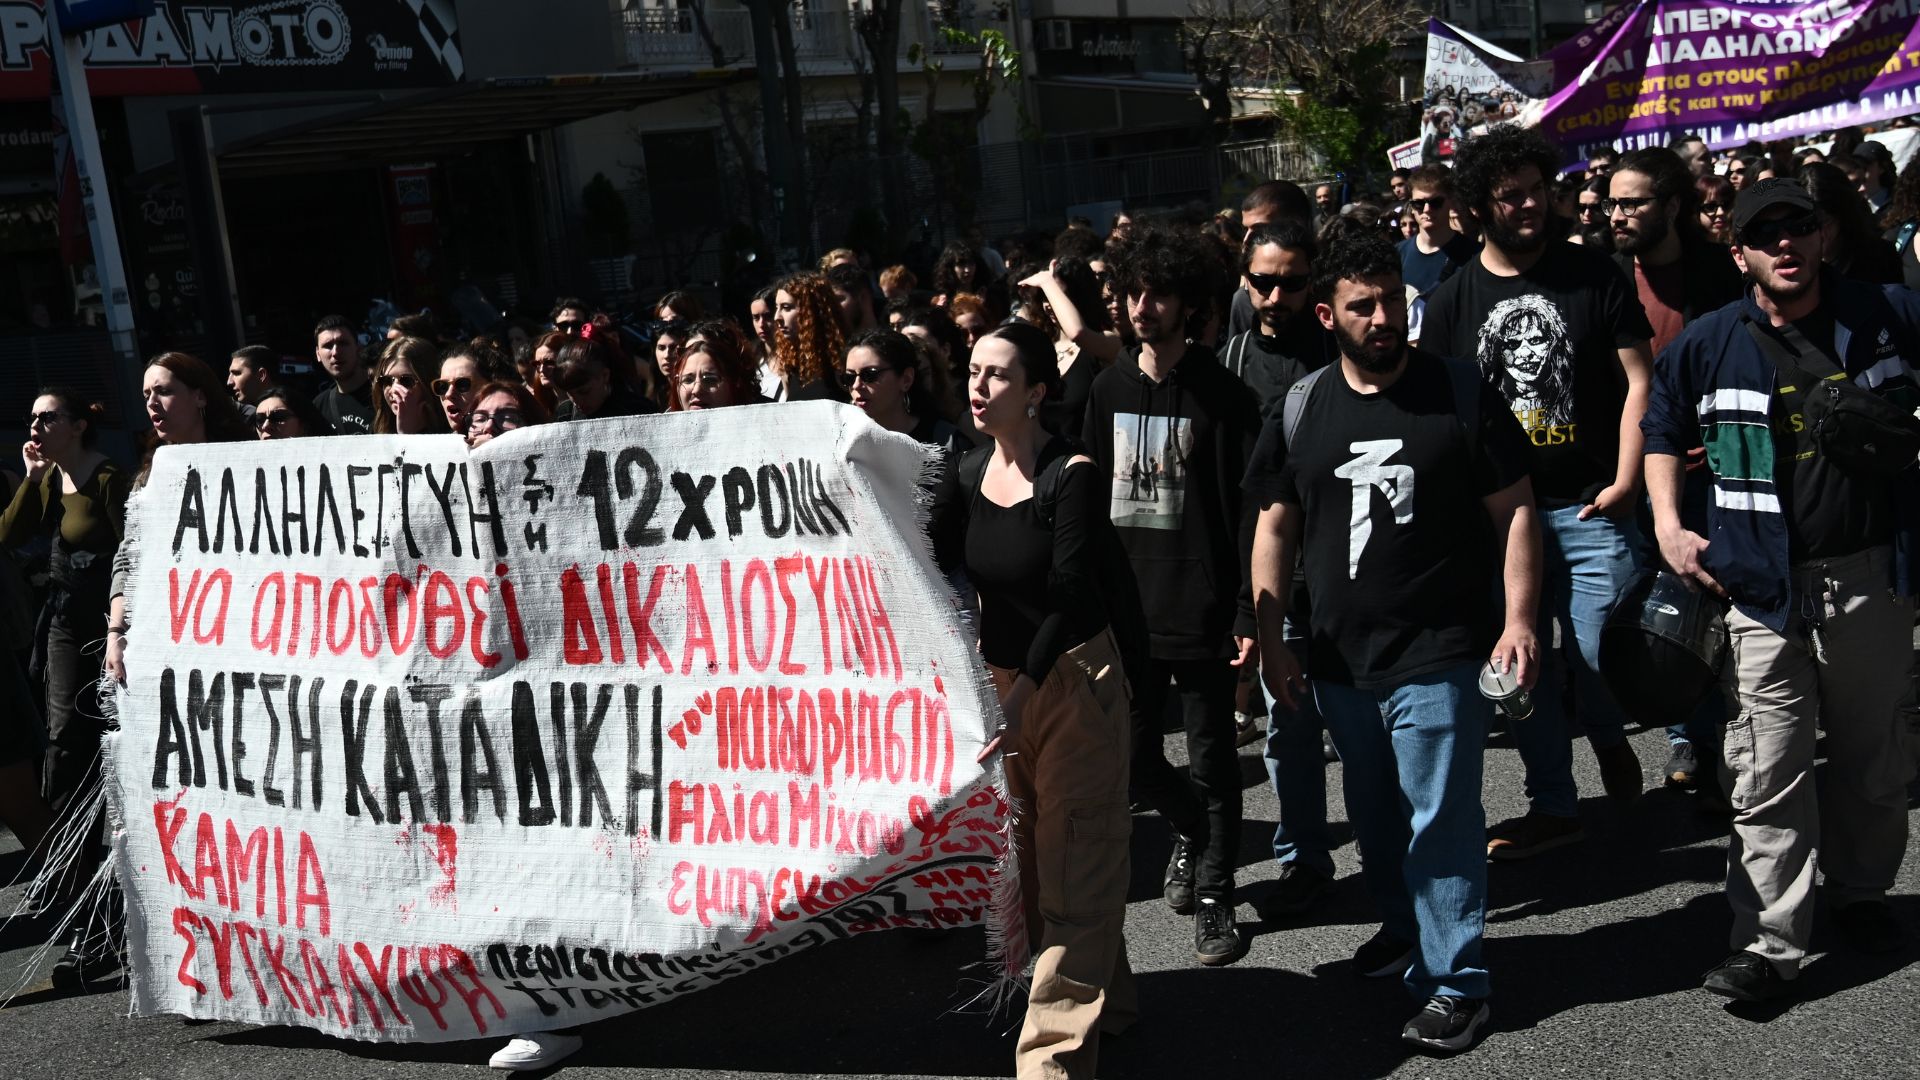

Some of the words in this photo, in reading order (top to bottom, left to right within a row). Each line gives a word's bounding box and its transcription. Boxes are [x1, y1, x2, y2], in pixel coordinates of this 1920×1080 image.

[1, 2, 346, 70] ΡΔΑΜΟΤΟ
[1644, 0, 1852, 37] ΑΠΕΡΓΟΥΜΕ
[1688, 97, 1718, 110] και
[1722, 93, 1755, 108] την
[1697, 66, 1769, 88] στους
[172, 456, 508, 560] ΑΛΛΗΛΕΓΓΥΗ
[169, 566, 232, 646] να
[562, 553, 903, 682] ΔΙΚΑΙΟΣΥΝΗ
[152, 668, 325, 812] ΑΜΕΣΗ
[340, 675, 664, 843] ΚΑΤΑΔΙΚΗ
[669, 780, 780, 846] Ηλία
[152, 790, 330, 937] ΚΑΜΙΑ
[172, 907, 506, 1035] ΣΥΓΚΑΛΥΨΗ
